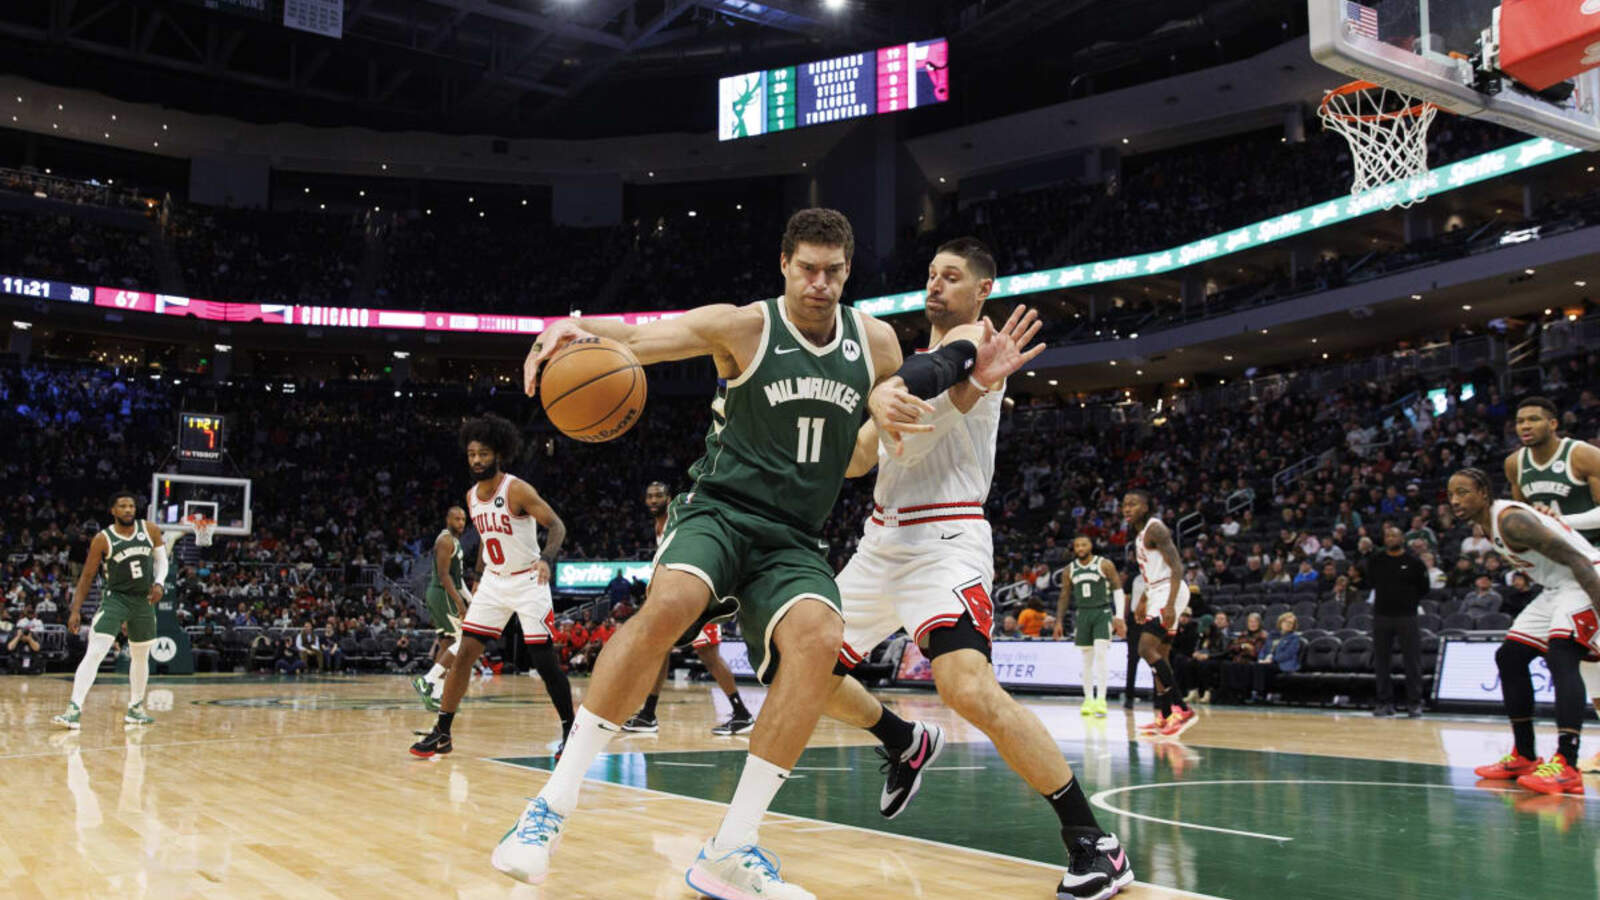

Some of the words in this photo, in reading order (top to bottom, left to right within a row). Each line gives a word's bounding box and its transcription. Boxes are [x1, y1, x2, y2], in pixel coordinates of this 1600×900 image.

[816, 80, 855, 98] STEALS
[815, 93, 856, 110] BLOCKS
[1091, 258, 1138, 282] Sprite
[1178, 239, 1218, 265] Sprite
[1257, 213, 1302, 242] Sprite
[1448, 152, 1507, 186] Sprite
[3, 277, 50, 298] 11:21
[115, 290, 140, 309] 67
[302, 305, 369, 327] CHICAGO
[763, 376, 862, 414] MILWAUKEE
[796, 416, 826, 464] 11
[473, 512, 513, 536] ULLS
[486, 538, 505, 565] 0
[130, 560, 144, 579] 6
[559, 564, 612, 586] Sprite
[1082, 583, 1091, 598] 0
[993, 664, 1035, 678] TTER
